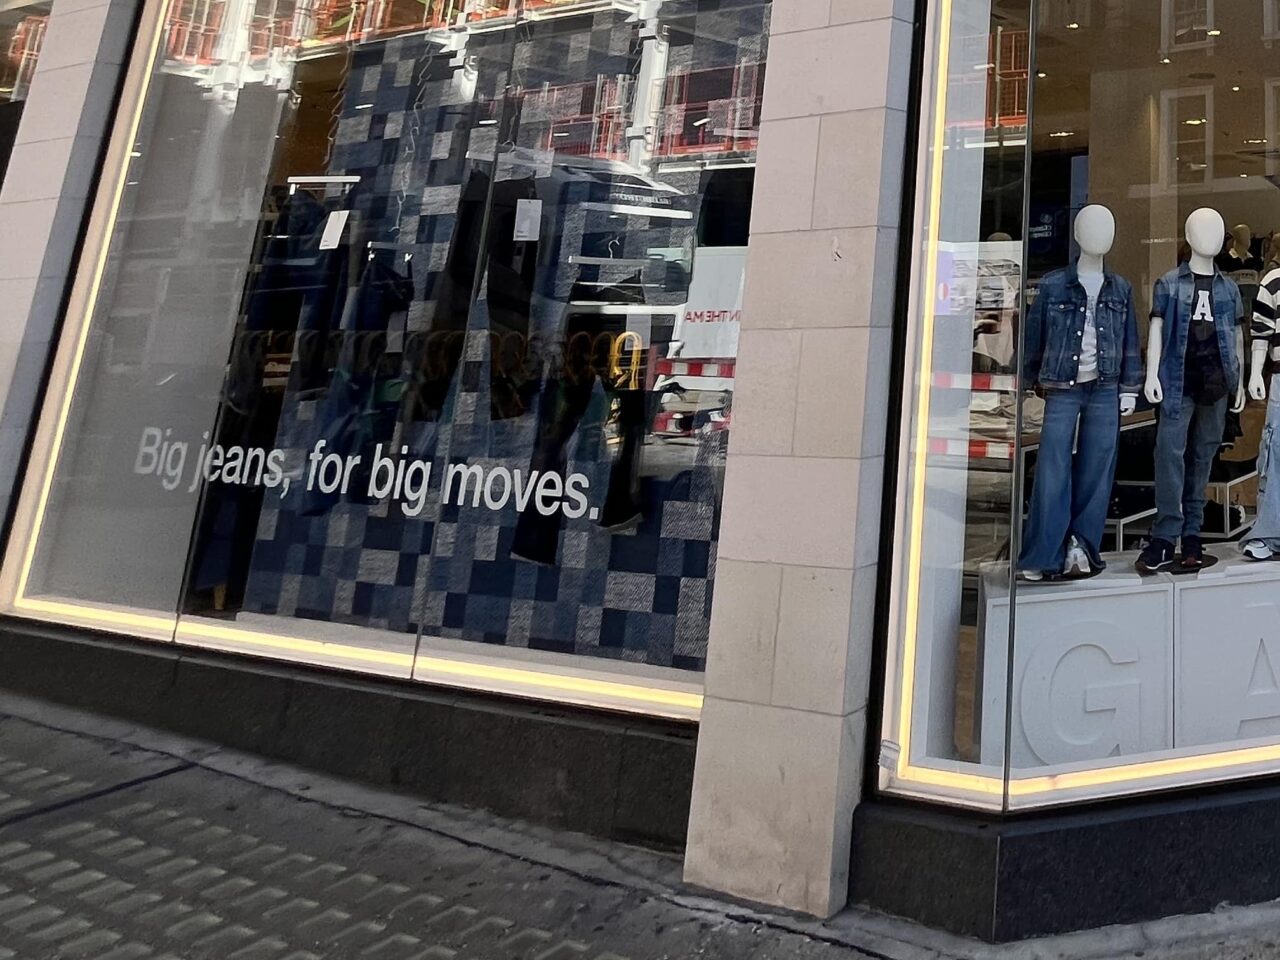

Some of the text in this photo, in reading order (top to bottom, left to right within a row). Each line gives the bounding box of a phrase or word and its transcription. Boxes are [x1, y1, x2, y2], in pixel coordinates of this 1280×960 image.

[134, 426, 600, 521] Big jeans, for big moves.
